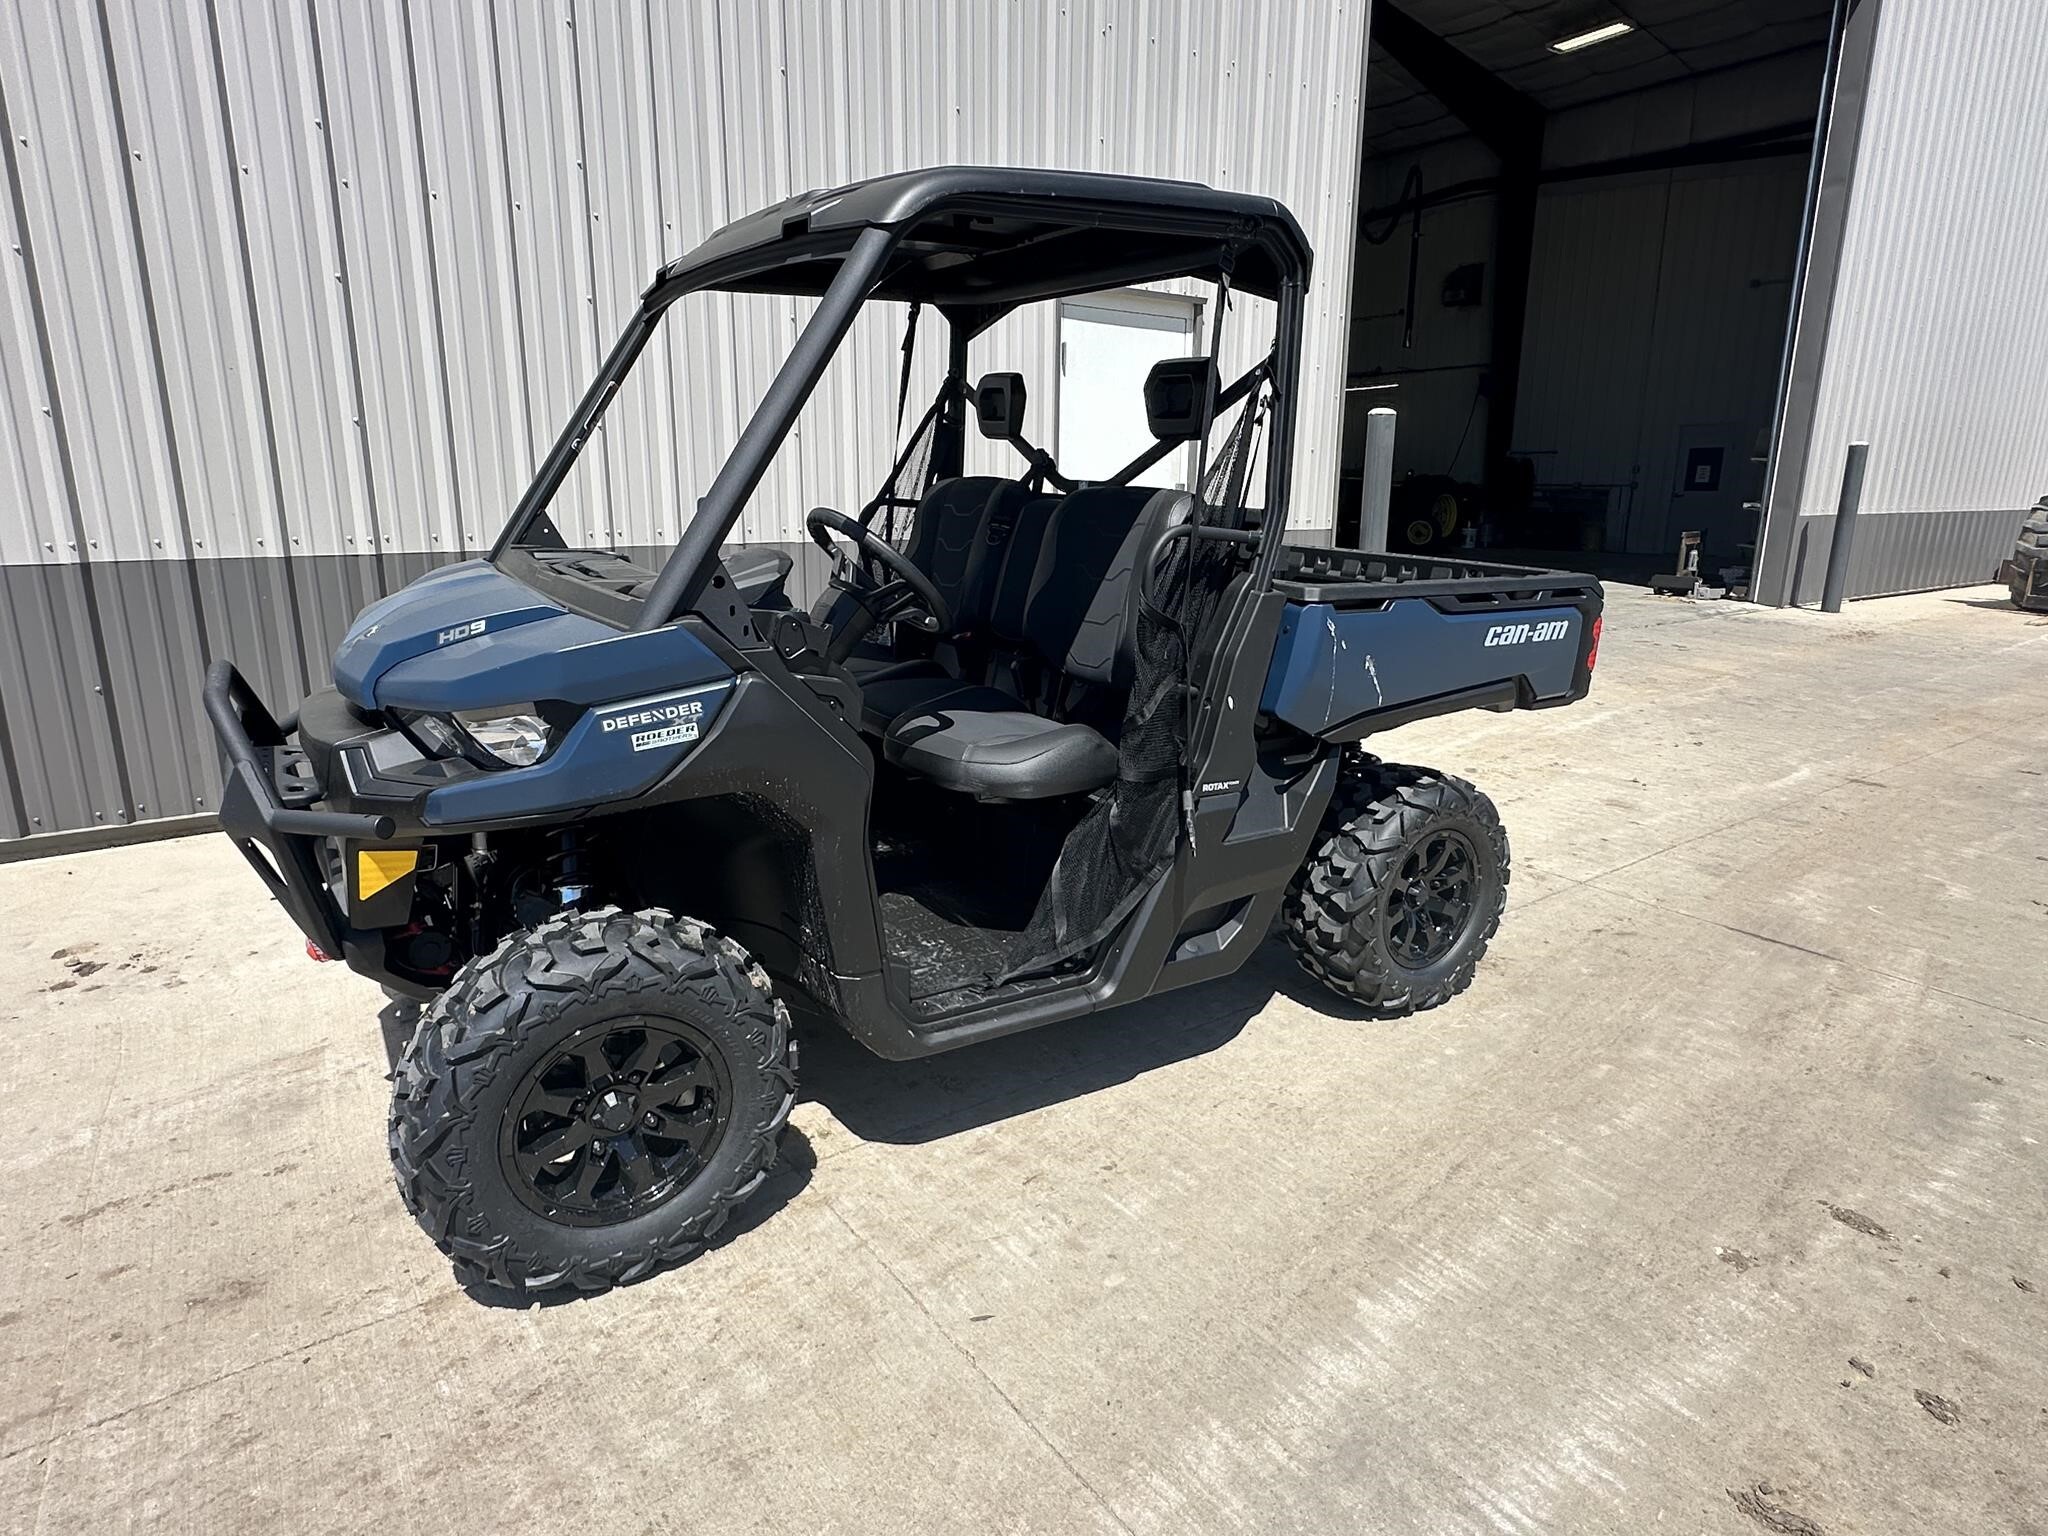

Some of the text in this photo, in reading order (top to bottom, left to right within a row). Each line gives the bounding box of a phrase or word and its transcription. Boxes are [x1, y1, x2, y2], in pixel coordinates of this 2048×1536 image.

[439, 619, 486, 645] HD9
[1484, 620, 1569, 647] can-am
[602, 701, 703, 732] DEFENDER
[672, 713, 703, 726] XT
[635, 725, 695, 743] ROEDER
[1202, 781, 1229, 792] ROTAX
